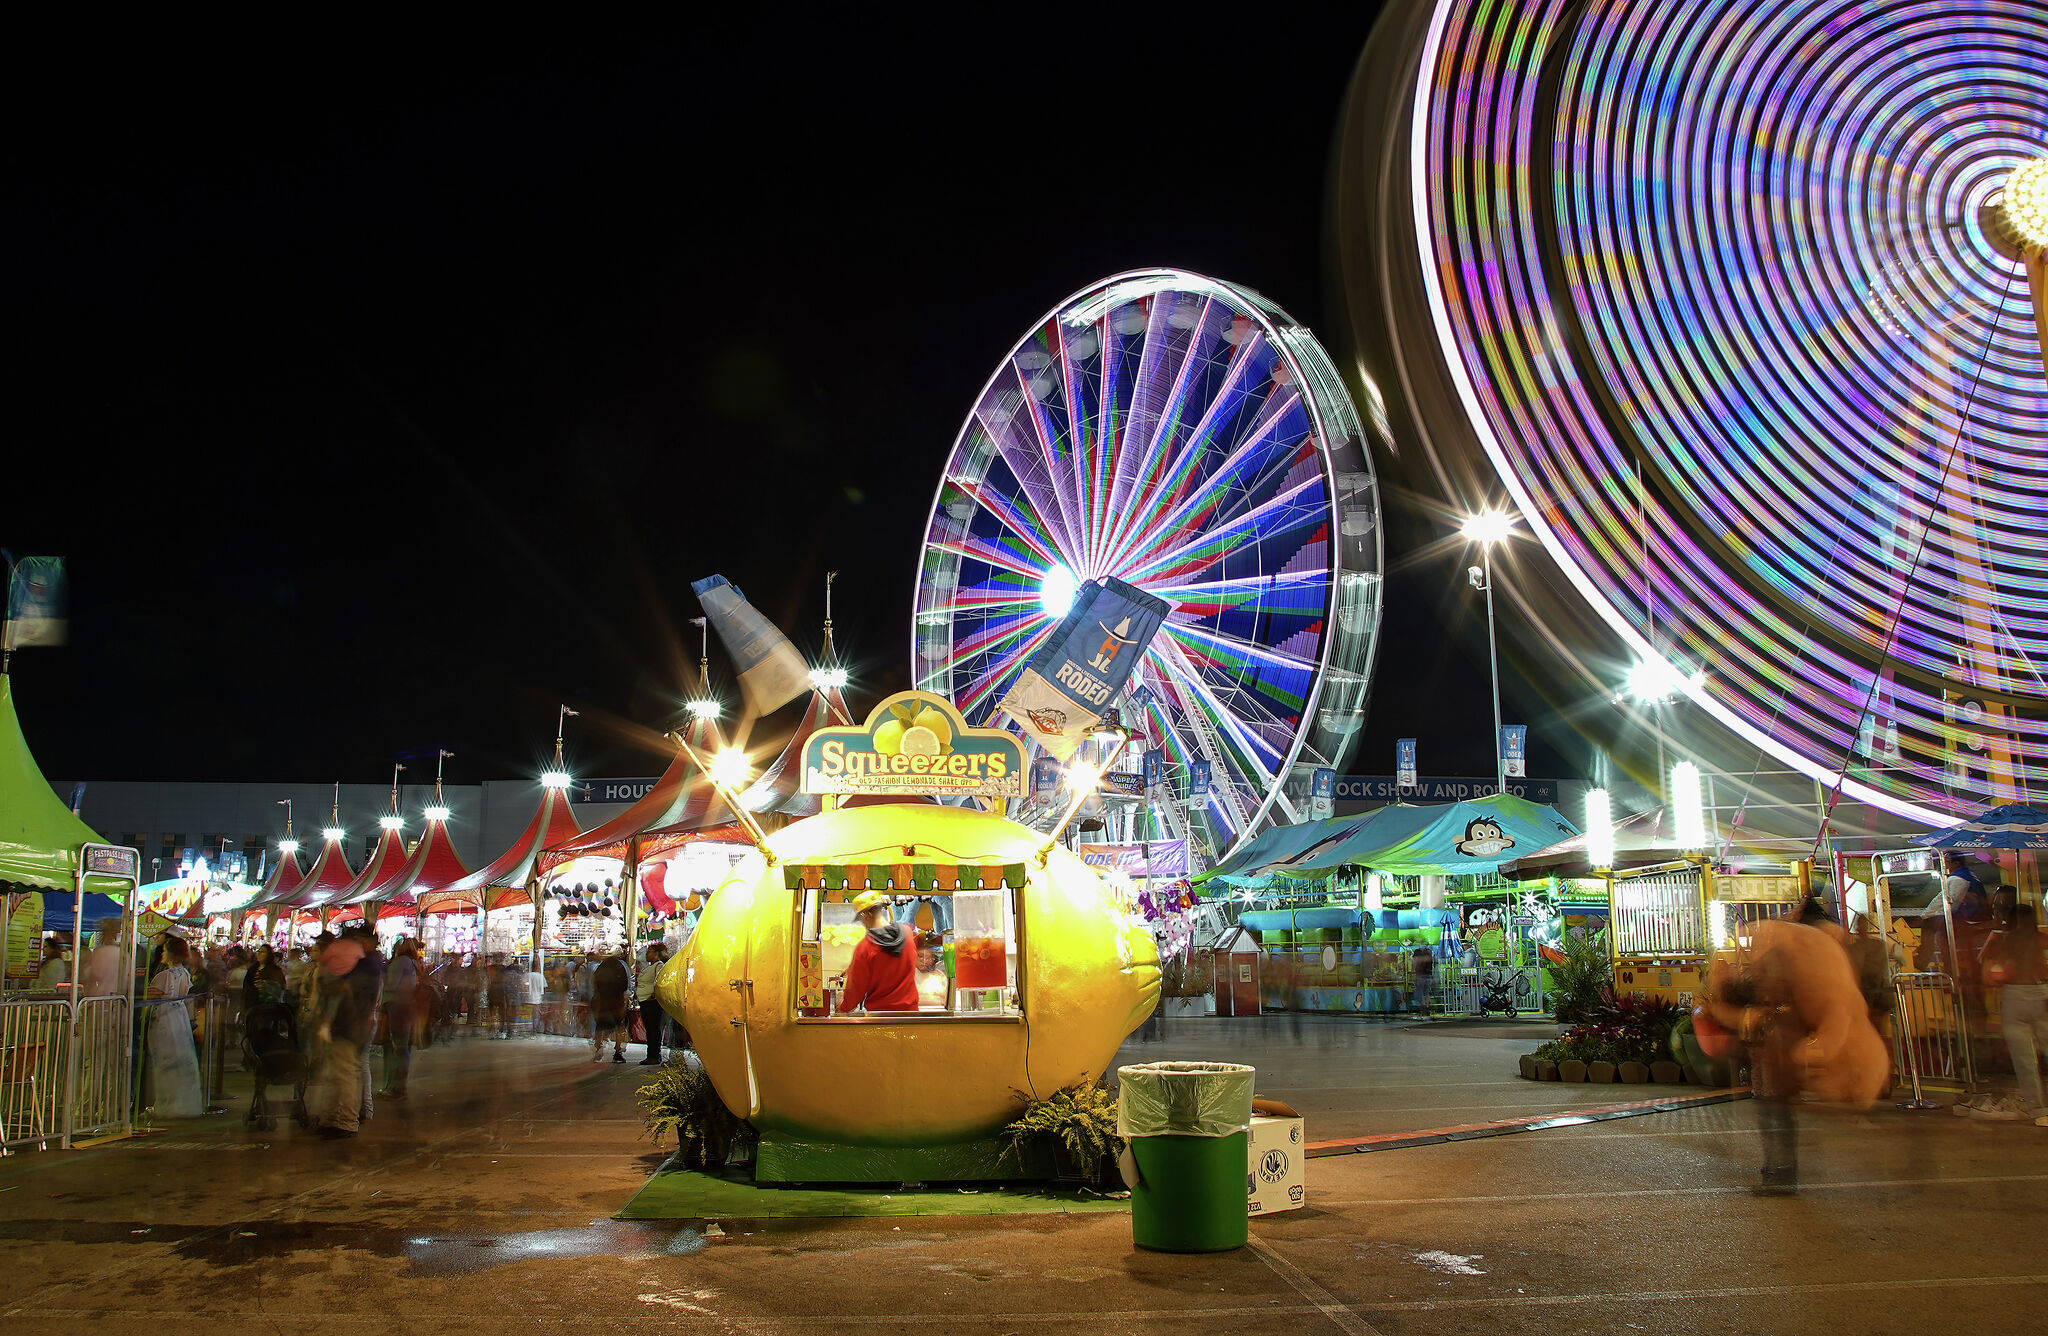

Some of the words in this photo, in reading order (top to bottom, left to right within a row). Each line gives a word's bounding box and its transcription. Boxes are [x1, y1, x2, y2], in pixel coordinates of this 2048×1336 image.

[1055, 663, 1109, 706] RODEO
[821, 739, 1007, 778] Squeezers
[874, 777, 901, 785] FASHION
[903, 777, 937, 785] LEMONADE
[939, 778, 959, 786] SHAKE
[605, 784, 654, 799] HOUS
[1377, 783, 1428, 797] SHOW
[1434, 783, 1468, 797] AND
[94, 850, 118, 858] FASTPASS
[1716, 879, 1793, 896] ENTER
[150, 884, 197, 912] CLOWN
[1262, 1168, 1285, 1183] REYMA
